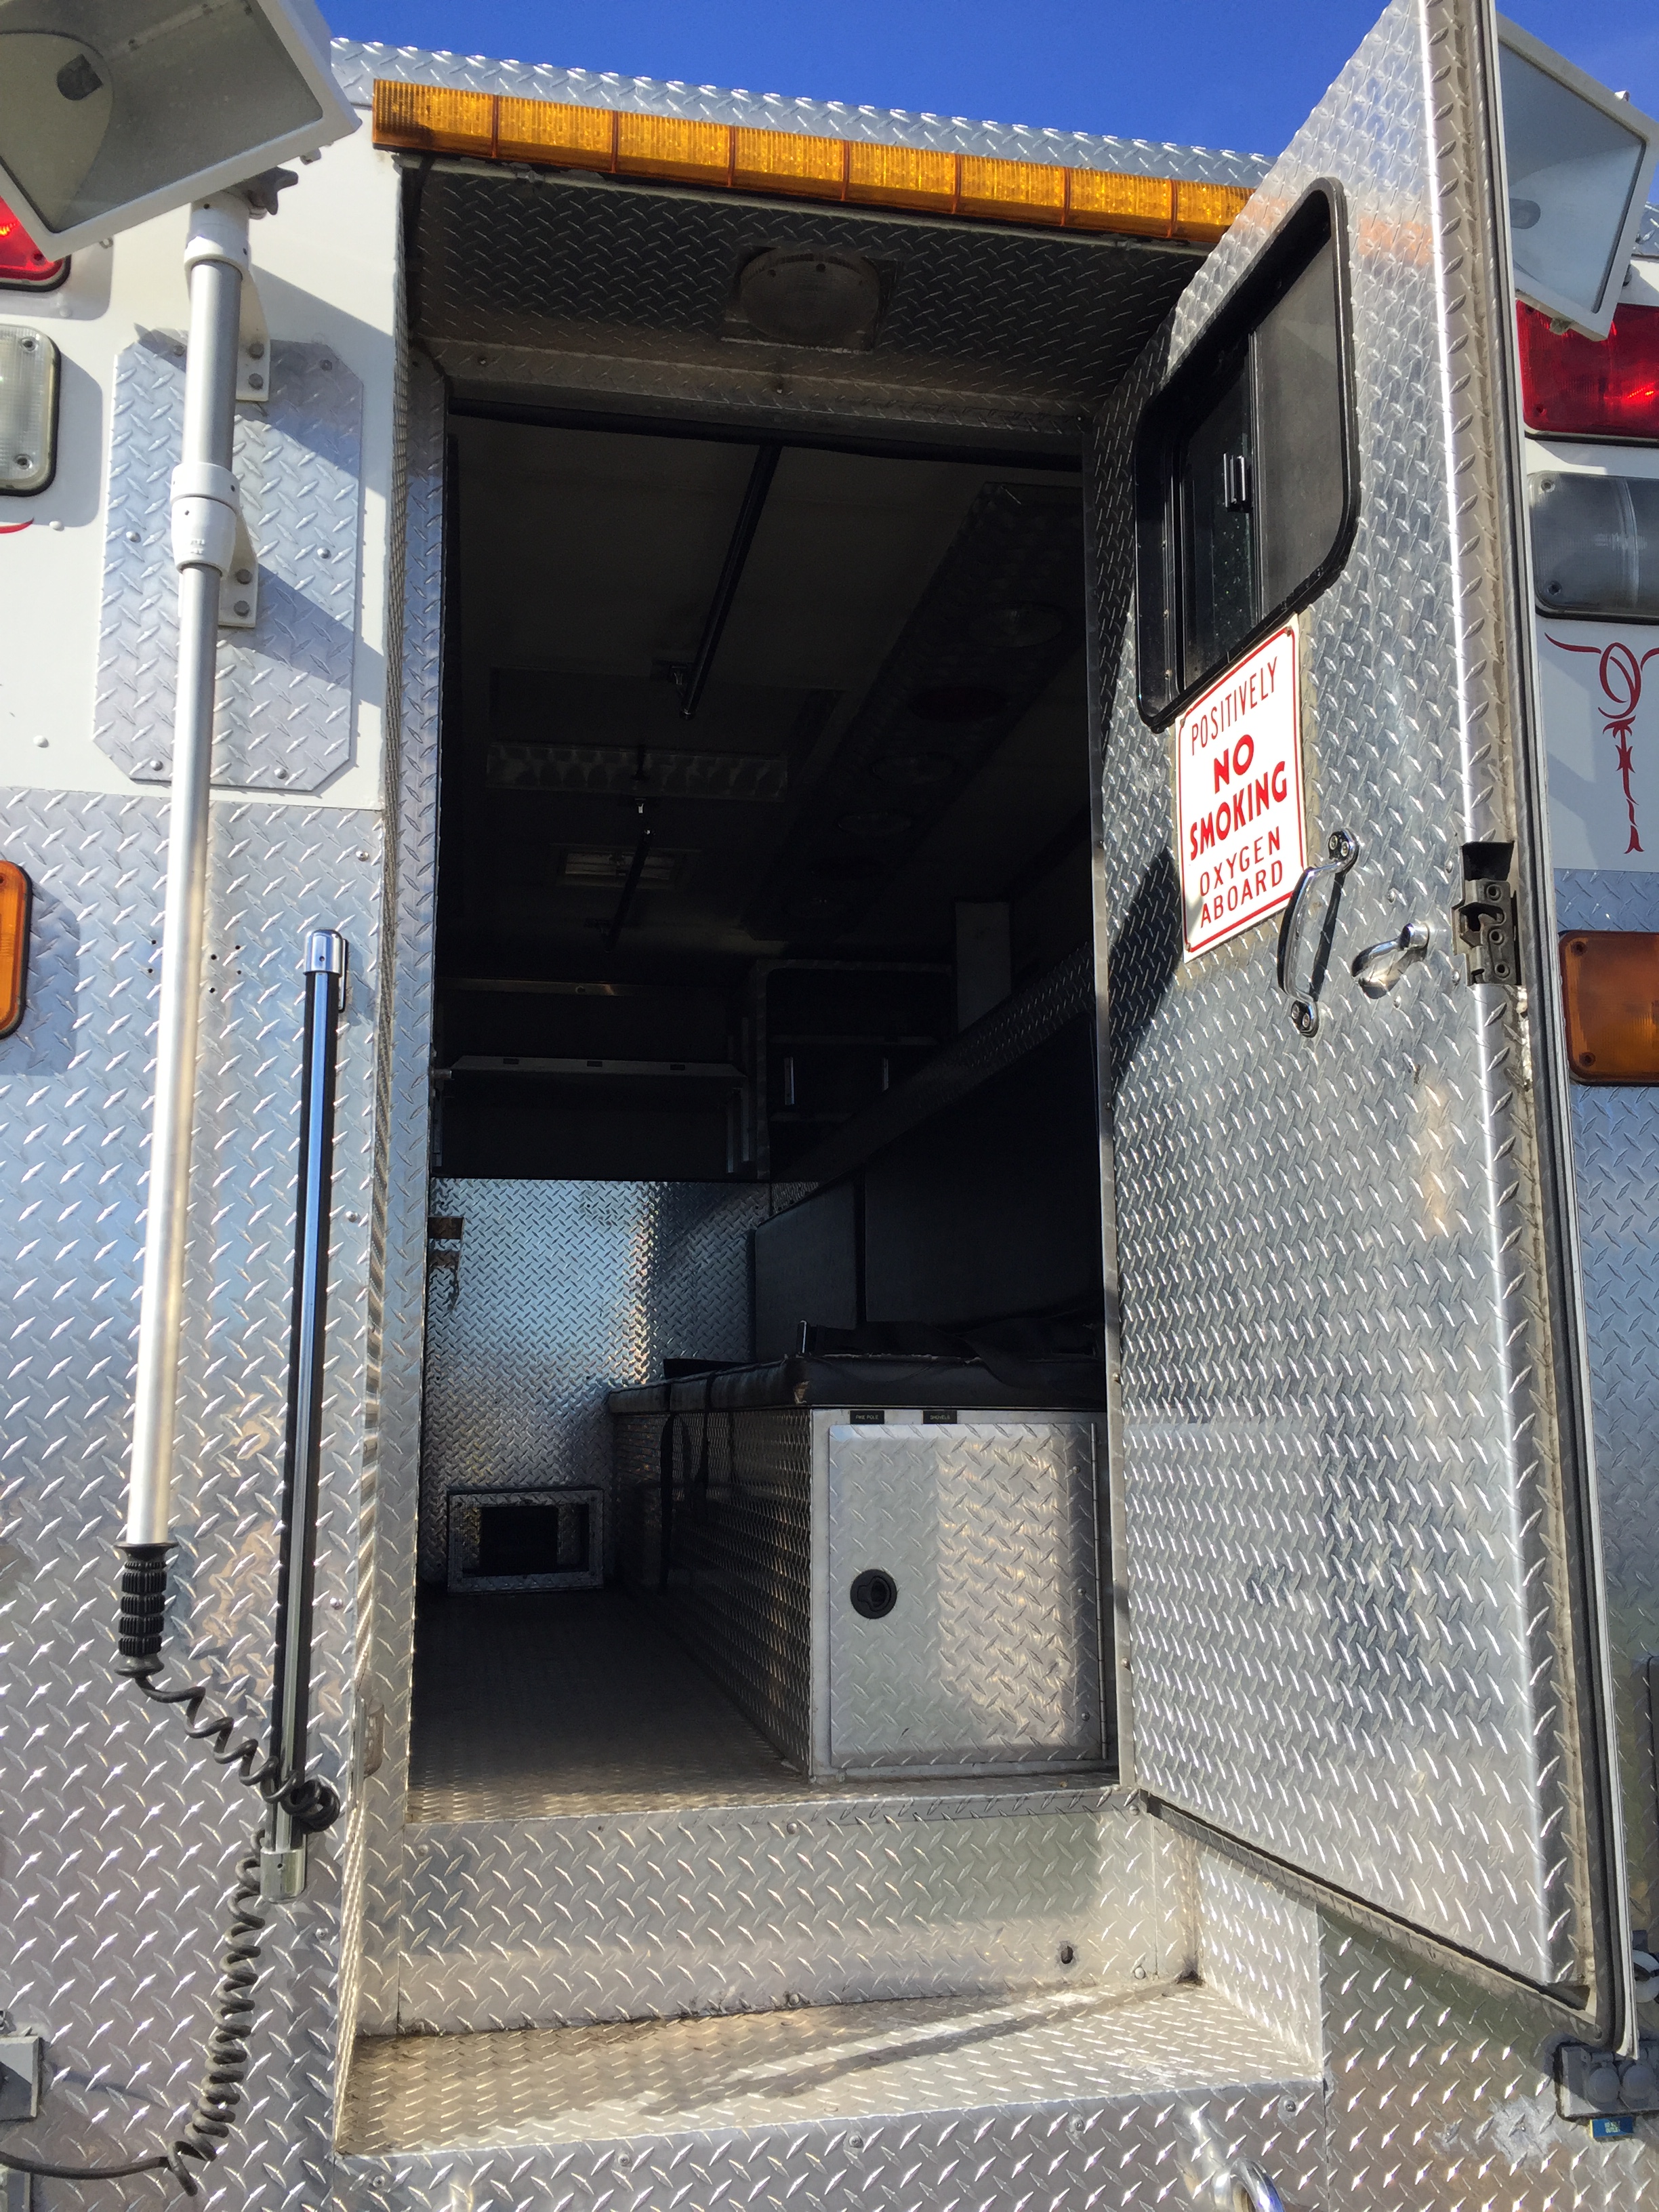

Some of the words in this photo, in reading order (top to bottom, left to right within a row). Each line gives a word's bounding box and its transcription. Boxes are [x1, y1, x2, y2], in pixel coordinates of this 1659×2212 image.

[1191, 657, 1277, 756] POSITIVELY
[1214, 734, 1254, 794] NO
[1190, 761, 1287, 861] SMOKING
[1200, 827, 1280, 897] OXYGEN
[1201, 860, 1283, 928] ABOARD
